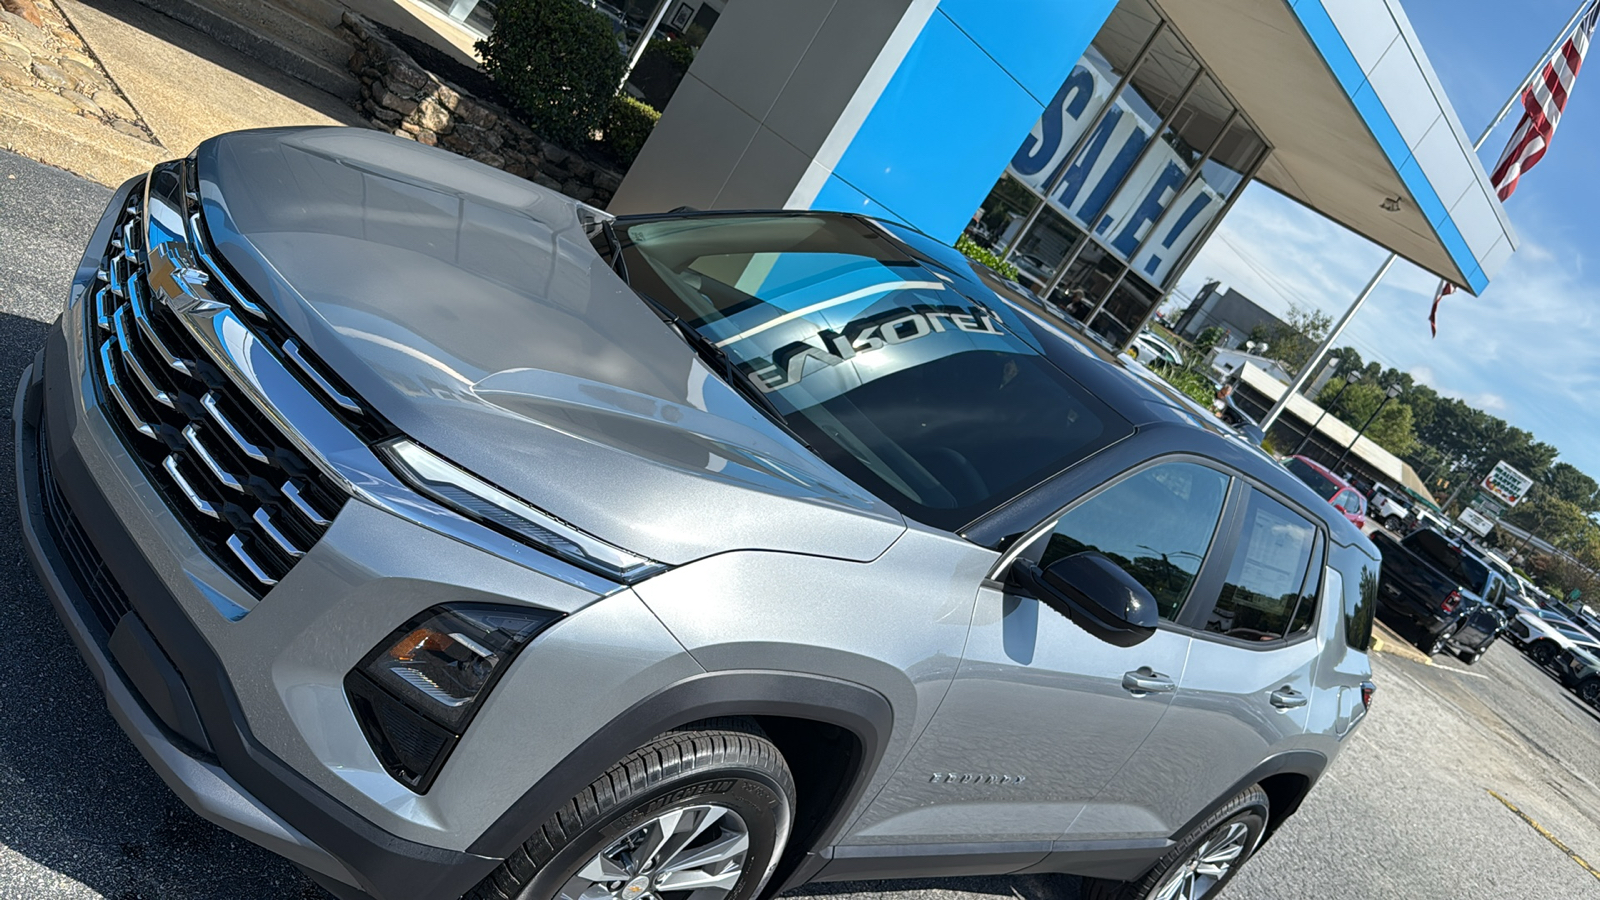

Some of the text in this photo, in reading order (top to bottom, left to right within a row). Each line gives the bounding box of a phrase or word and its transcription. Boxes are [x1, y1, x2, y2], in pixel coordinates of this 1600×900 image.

[1011, 64, 1212, 276] SALE!
[1494, 473, 1521, 492] HARVEST
[646, 780, 737, 813] MICHELIN
